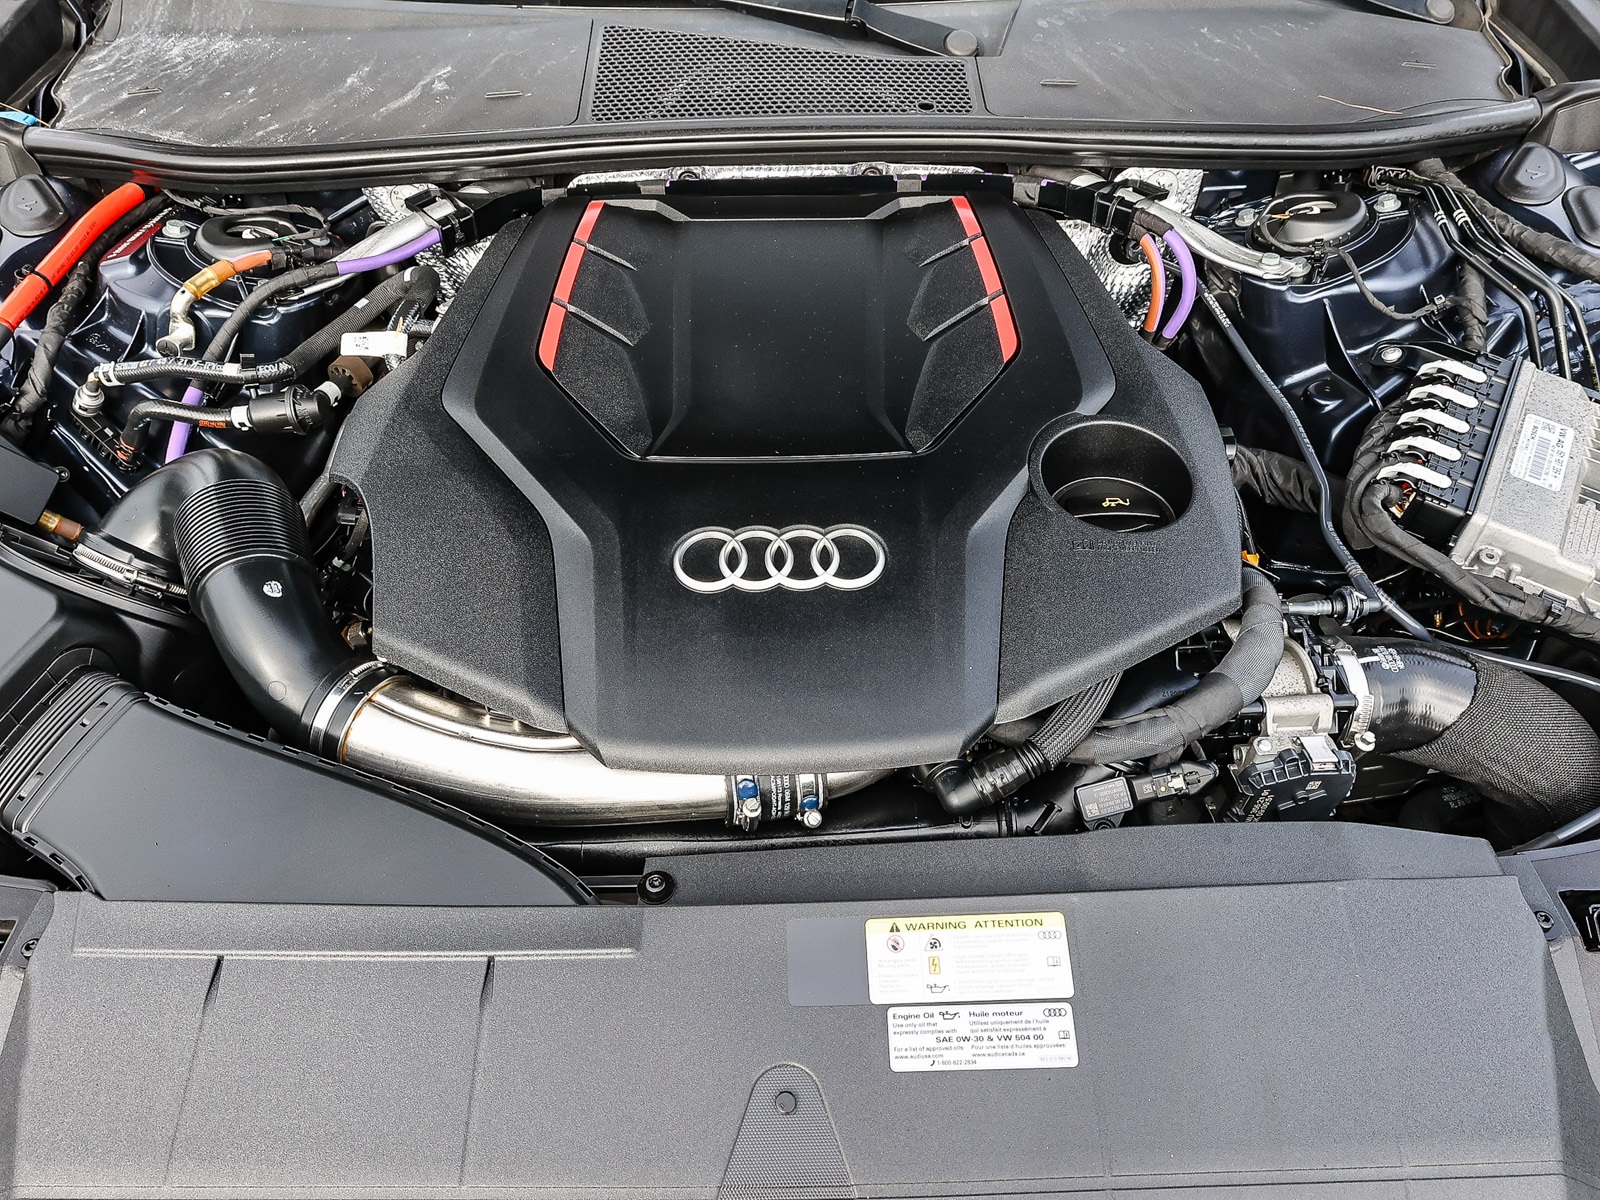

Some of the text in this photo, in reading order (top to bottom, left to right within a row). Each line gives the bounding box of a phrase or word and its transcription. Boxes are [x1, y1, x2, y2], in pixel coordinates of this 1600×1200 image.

[905, 918, 1044, 931] WARNING ATTENTION
[892, 1012, 920, 1020] Engine
